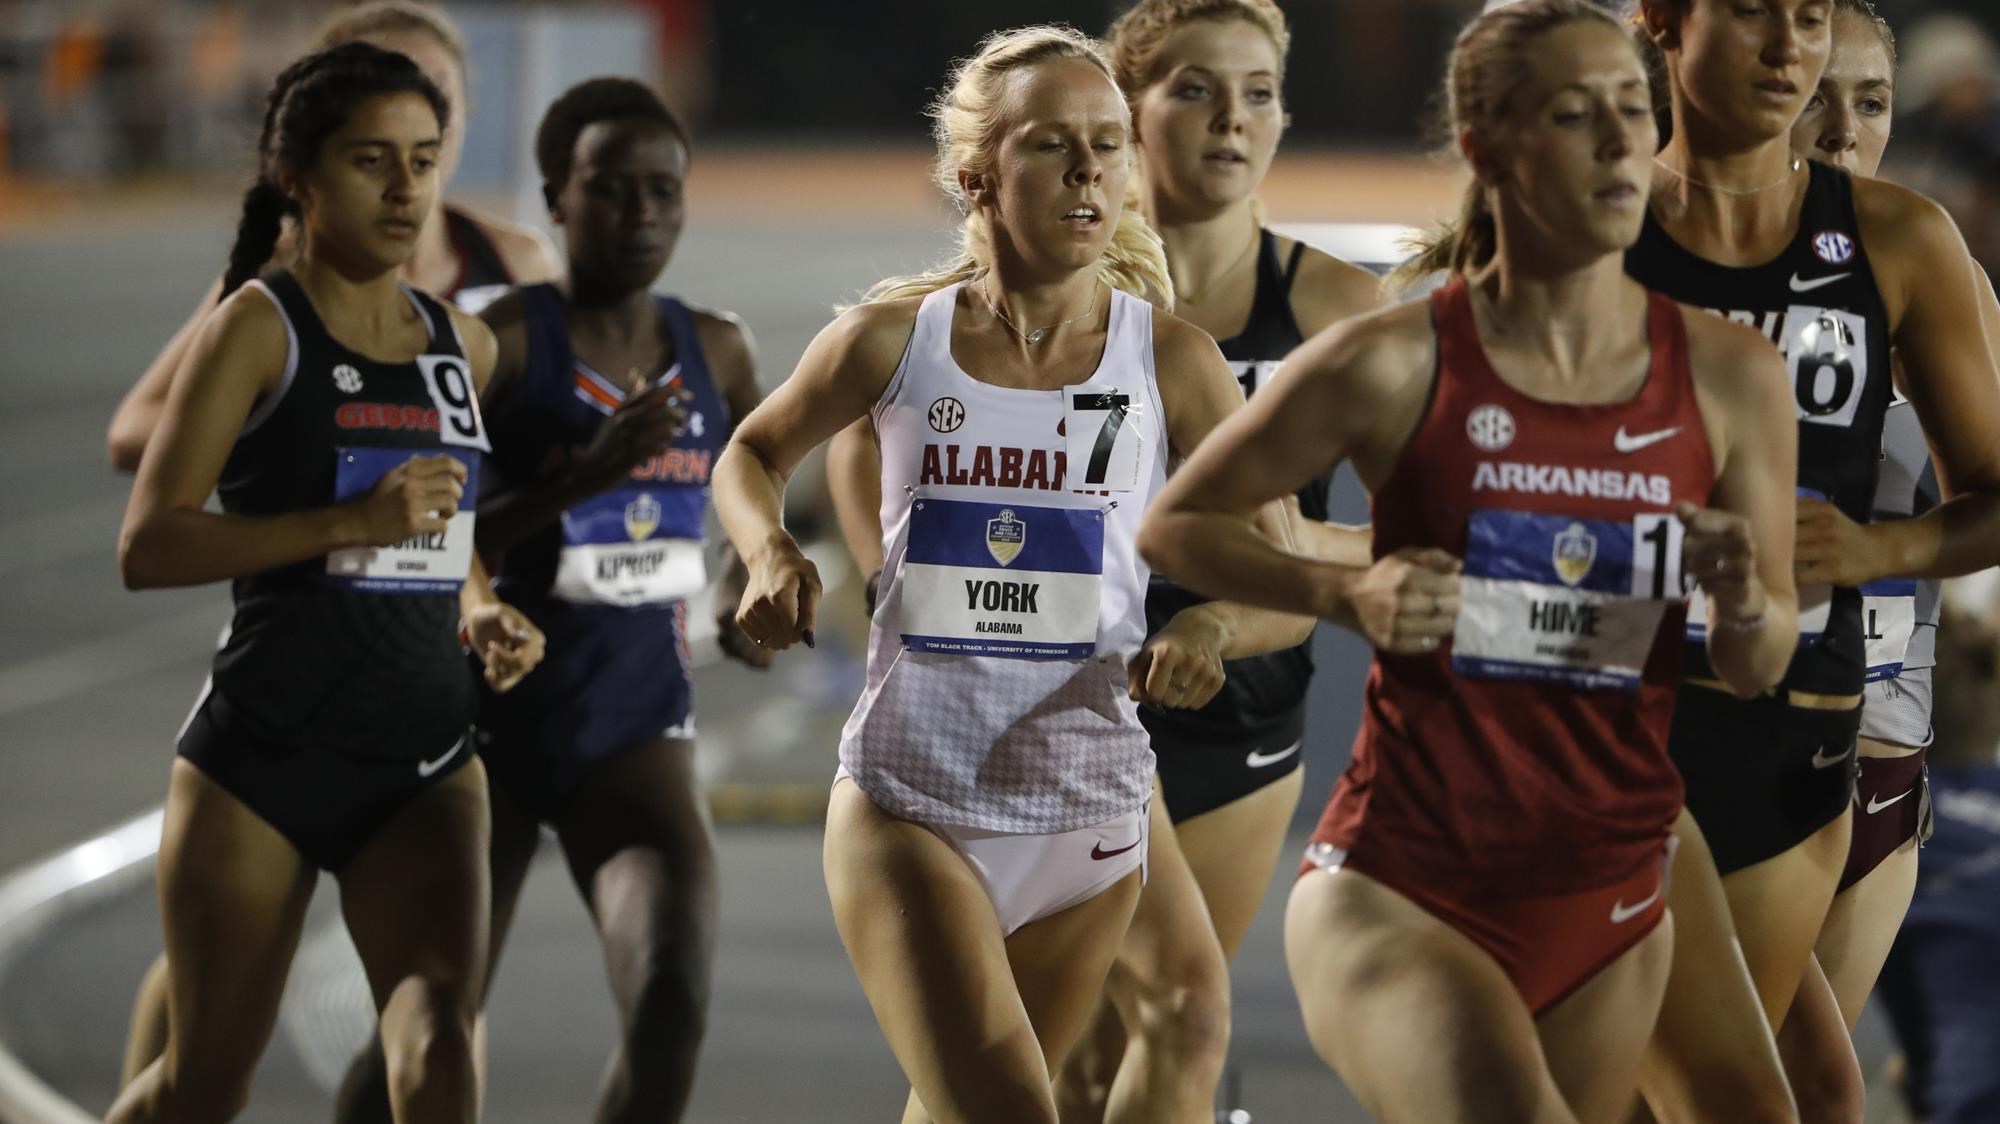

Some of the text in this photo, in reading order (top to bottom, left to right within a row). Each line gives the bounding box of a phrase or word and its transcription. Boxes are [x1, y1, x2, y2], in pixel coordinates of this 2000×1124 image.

[1796, 318, 1855, 416] 6
[335, 402, 441, 432] GEORG
[434, 362, 478, 438] 9
[928, 397, 965, 433] SEC
[1073, 394, 1130, 484] 7
[920, 444, 1109, 497] ALABA
[1472, 462, 1672, 505] ARKANSAS
[965, 579, 1040, 614] YORK
[975, 621, 1023, 635] ALABAMA
[1864, 609, 1883, 640] L
